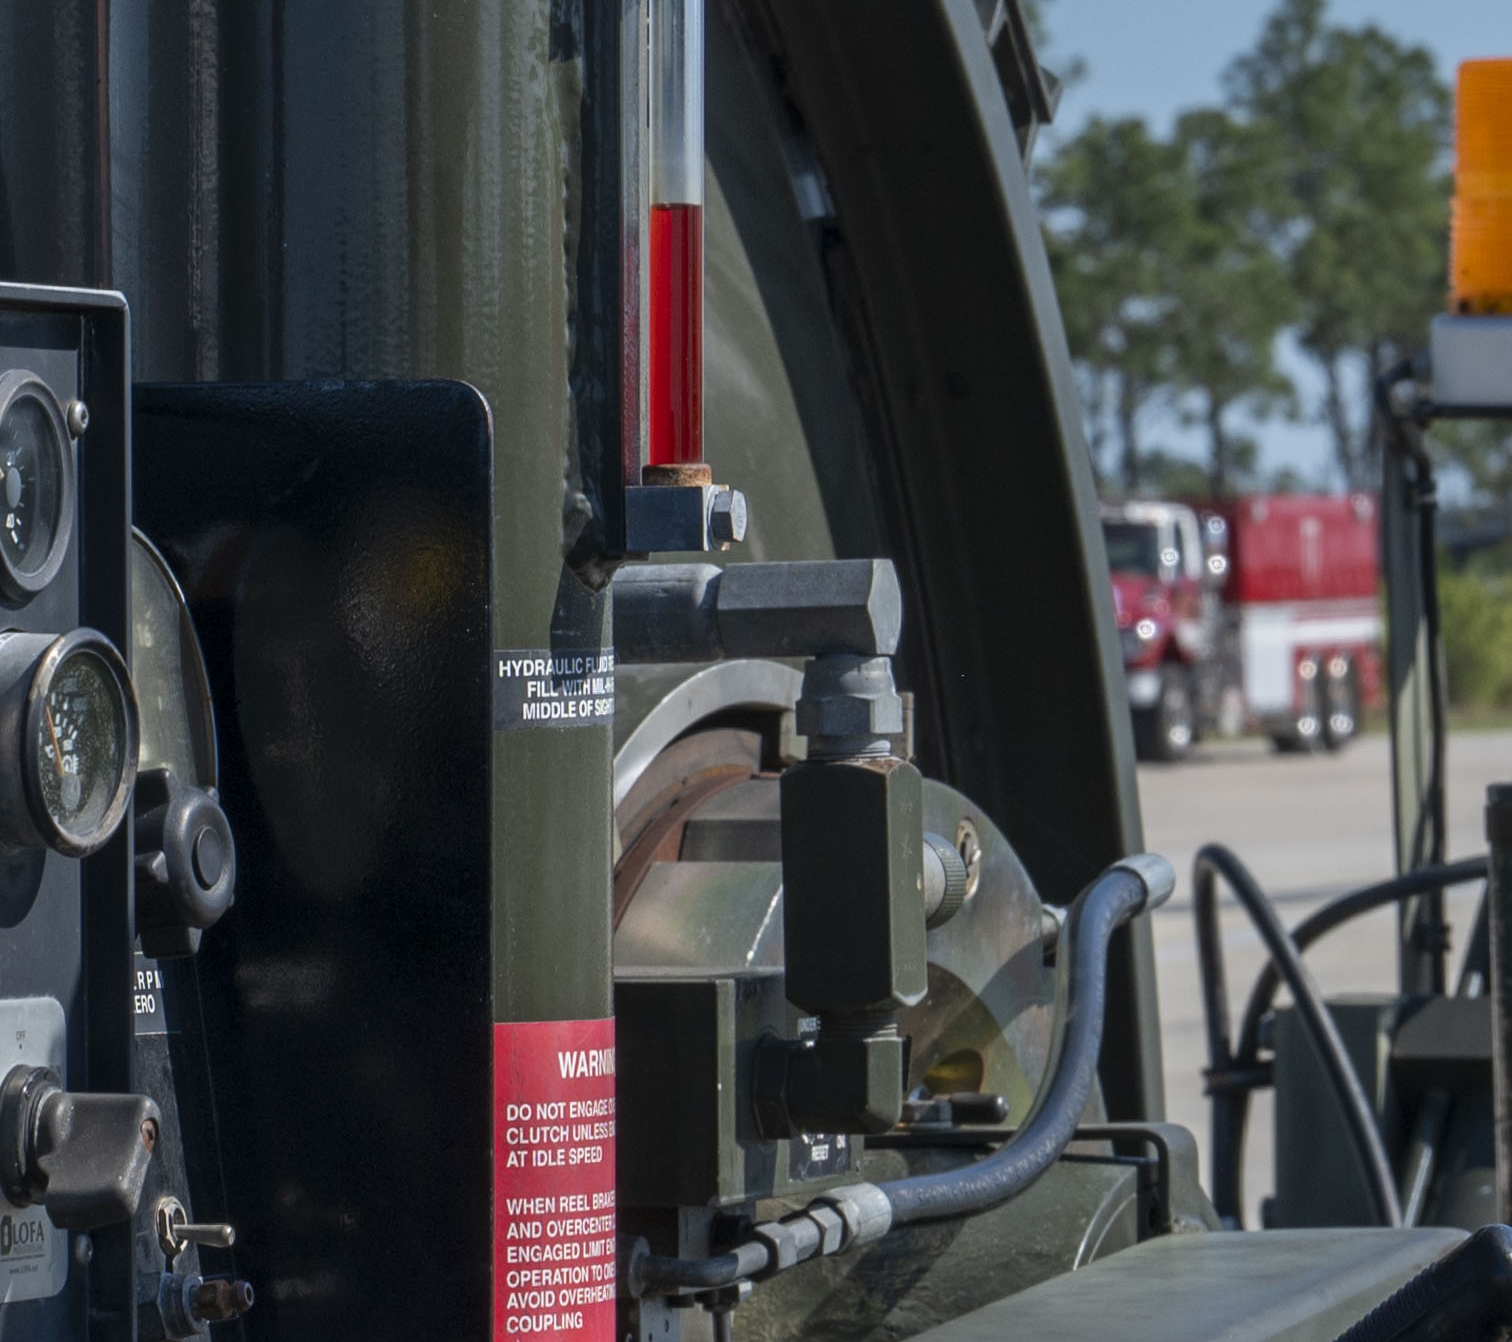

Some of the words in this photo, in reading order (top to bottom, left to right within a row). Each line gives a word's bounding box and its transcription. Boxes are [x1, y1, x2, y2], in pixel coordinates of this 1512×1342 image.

[498, 658, 583, 678] HYDRAULIC
[585, 656, 608, 674] FLUID
[527, 680, 560, 699] FILL
[562, 677, 590, 697] WITH
[522, 700, 576, 721] MIDDLE
[578, 699, 593, 718] OF
[133, 994, 156, 1014] ERO
[506, 1103, 532, 1122] DO
[536, 1102, 566, 1120] NOT
[570, 1099, 608, 1119] ENGAGE
[506, 1125, 569, 1145] CLUTCH
[573, 1122, 608, 1142] UNLESS
[506, 1150, 528, 1168] AT
[532, 1148, 566, 1167] IDLE
[569, 1146, 603, 1166] SPEED
[506, 1196, 556, 1216] WHEN
[560, 1194, 590, 1213] REEL
[12, 1219, 46, 1245] LOFA
[506, 1221, 542, 1240] AND
[546, 1216, 612, 1238] OVERCENTER
[507, 1242, 580, 1264] ENGAGED
[583, 1240, 605, 1258] LIMIT
[506, 1266, 589, 1288] OPERATION
[591, 1264, 602, 1282] TO
[506, 1290, 556, 1310] AVOID
[506, 1311, 584, 1334] COUPLING
